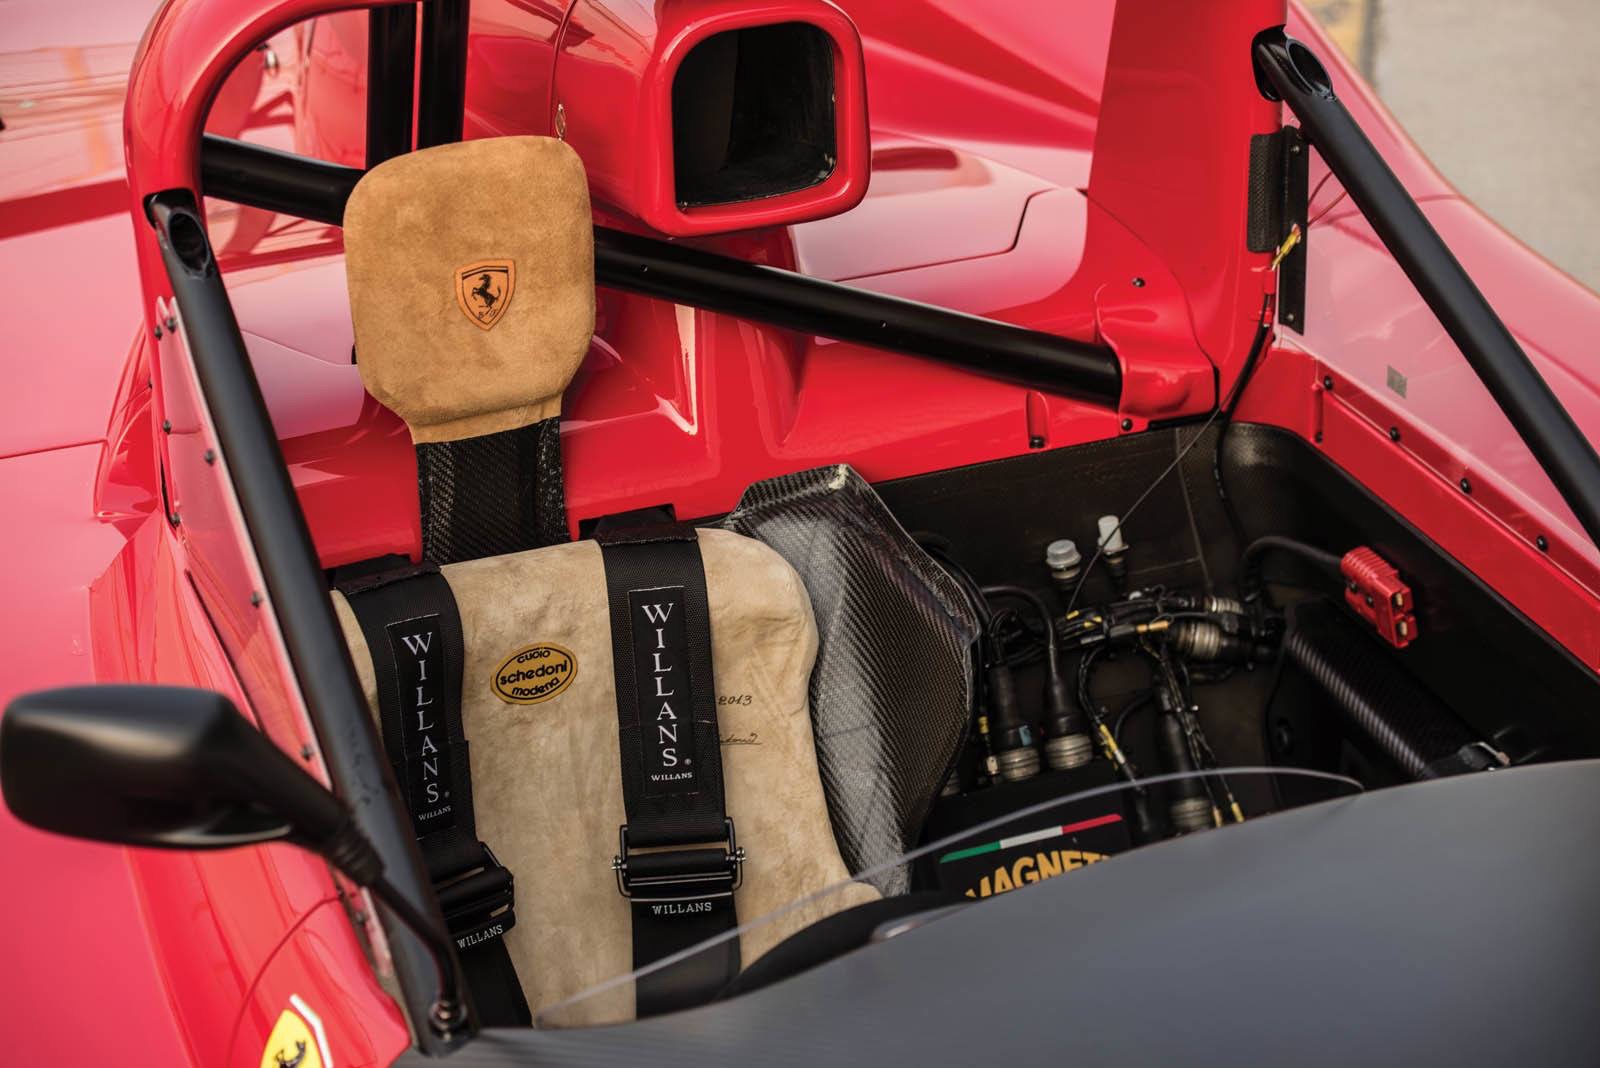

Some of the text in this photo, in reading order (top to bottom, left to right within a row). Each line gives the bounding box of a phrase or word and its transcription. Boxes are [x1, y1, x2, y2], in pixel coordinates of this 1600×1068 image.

[517, 650, 551, 663] cuoio
[500, 659, 568, 685] schedoni
[511, 677, 560, 696] modena
[642, 602, 679, 767] WILLANS
[402, 631, 441, 803] WILLANS
[651, 771, 693, 781] WILLANS
[418, 805, 451, 821] WILLANS
[965, 850, 1112, 898] AGNE
[652, 902, 712, 915] WILLANS
[456, 924, 504, 949] WILLANS
